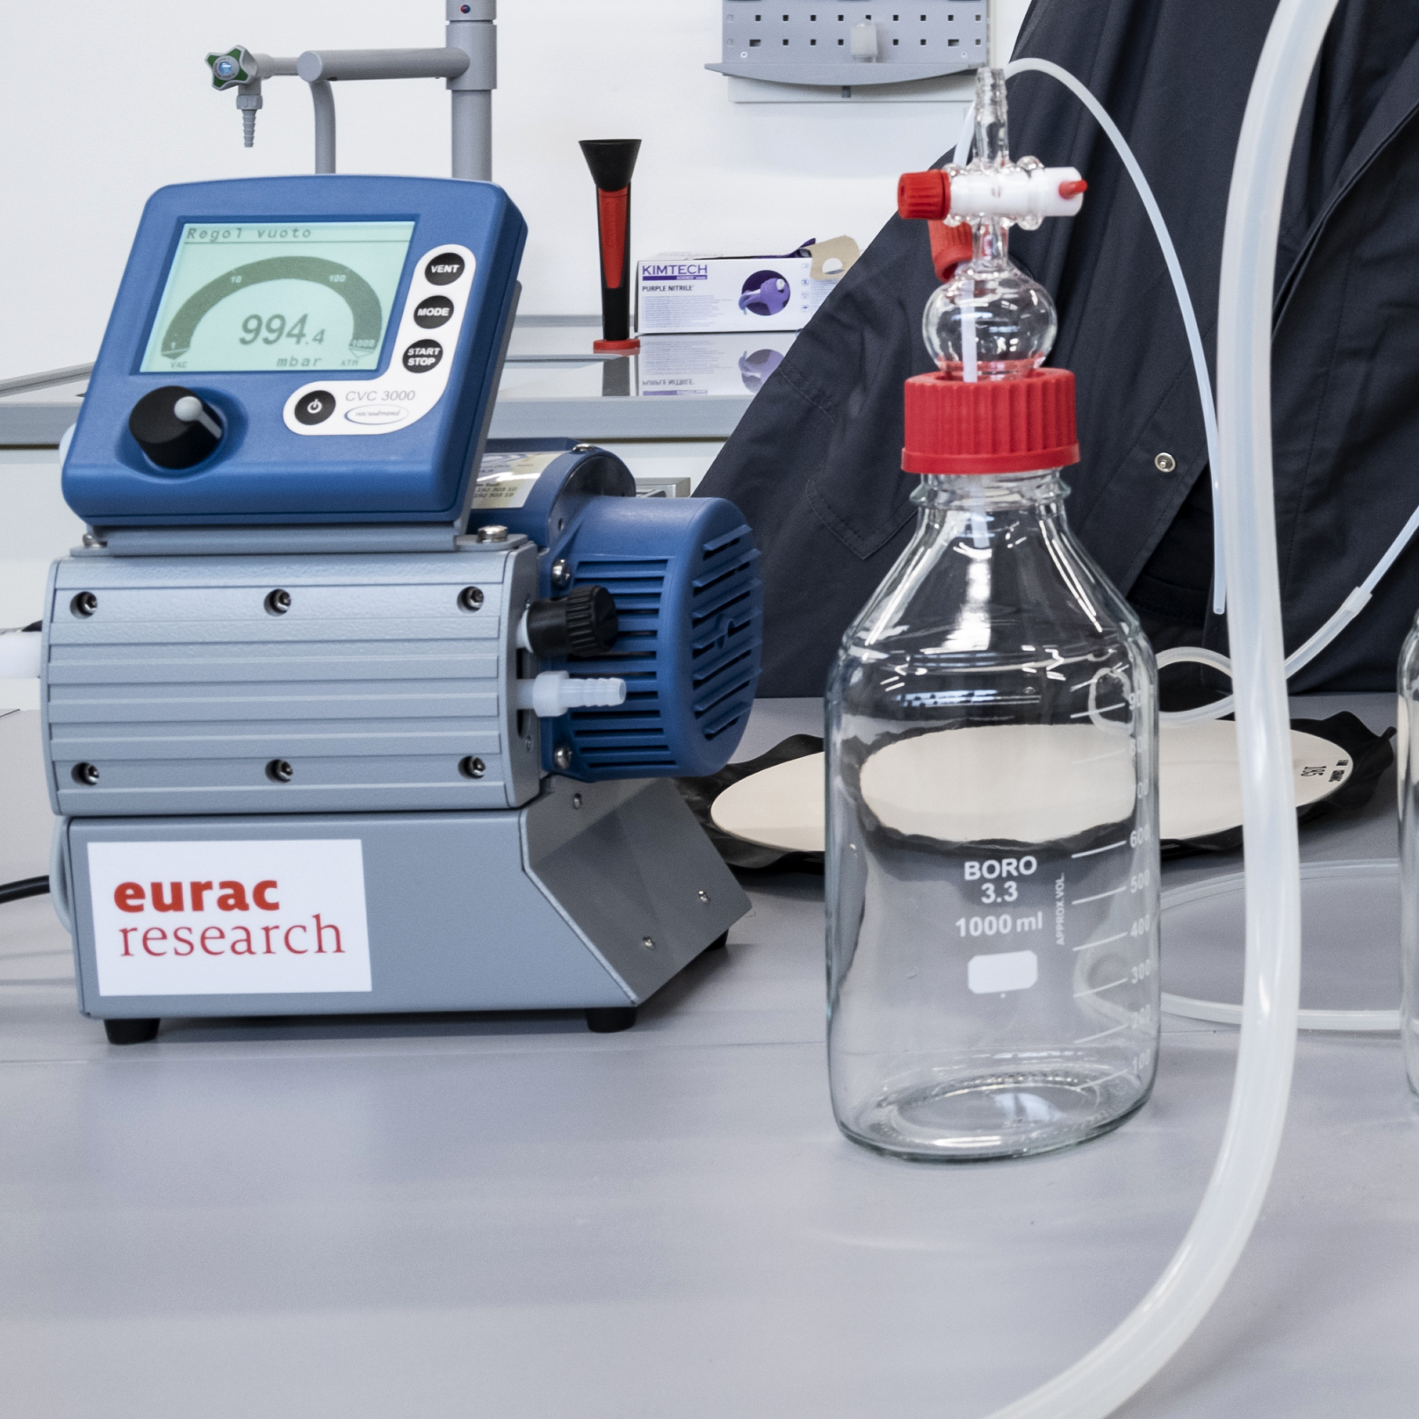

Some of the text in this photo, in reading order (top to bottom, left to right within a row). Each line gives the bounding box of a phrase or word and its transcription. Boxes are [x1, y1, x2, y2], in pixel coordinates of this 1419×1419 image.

[257, 228, 312, 239] vuoto
[431, 264, 460, 273] VENT
[642, 264, 708, 276] KIMTECH
[230, 275, 242, 283] 10
[328, 275, 346, 283] 100
[668, 284, 694, 292] NITRILE
[417, 307, 450, 317] MODE
[351, 339, 376, 348] 1000
[407, 347, 440, 356] START
[276, 355, 323, 368] mbar
[340, 359, 359, 367] ATM
[407, 357, 436, 366] STOP
[345, 389, 416, 402] CVC 3000
[964, 856, 1038, 881] BORO
[1130, 868, 1150, 893] 500
[113, 880, 280, 913] eurac
[980, 881, 1018, 904] 3.3
[955, 911, 1043, 937] 1000 ml
[1130, 914, 1150, 938] 400
[118, 913, 346, 957] research
[1131, 959, 1151, 984] 300
[1132, 1048, 1151, 1074] 100
